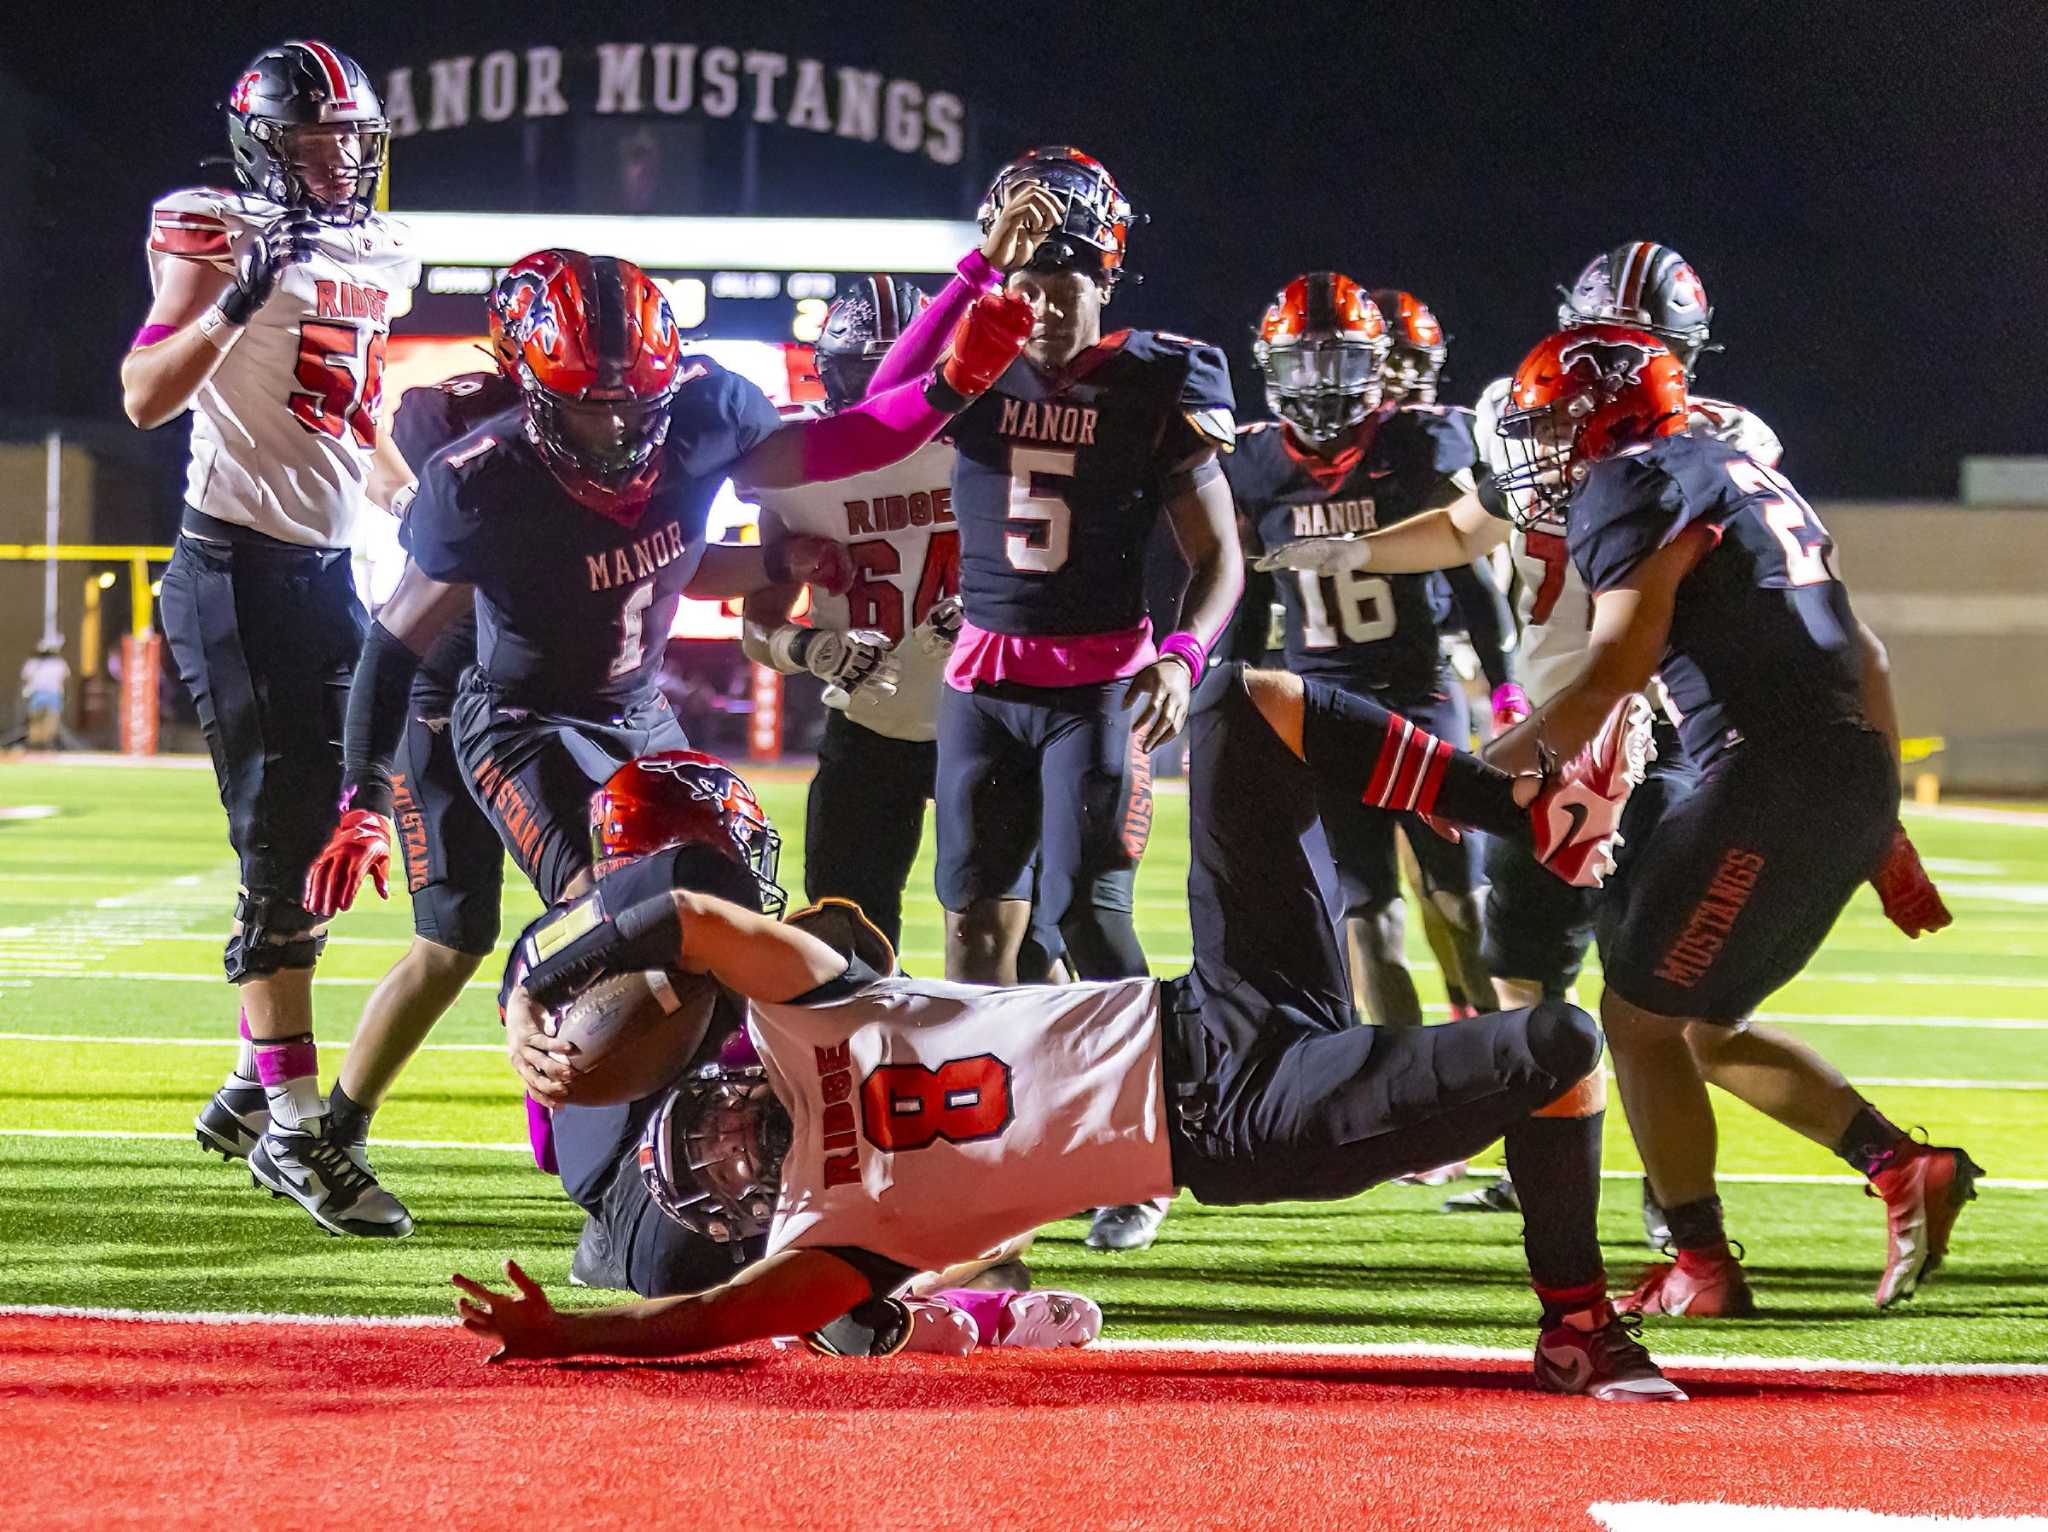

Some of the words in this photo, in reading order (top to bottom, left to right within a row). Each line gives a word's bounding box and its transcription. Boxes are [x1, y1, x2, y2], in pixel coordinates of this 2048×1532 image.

[384, 45, 569, 139] ANOR
[597, 42, 964, 165] MUSTANGS
[999, 398, 1099, 446] MANOR
[585, 520, 686, 592] MANOR
[844, 487, 958, 536] RIDGE
[1004, 446, 1078, 574] 5
[1292, 499, 1379, 538] MANOR
[607, 578, 656, 681] 1
[1289, 565, 1397, 649] 16
[1653, 848, 1766, 988] MUSTANGS
[814, 1037, 863, 1190] RIDGE
[860, 1053, 1016, 1154] 8
